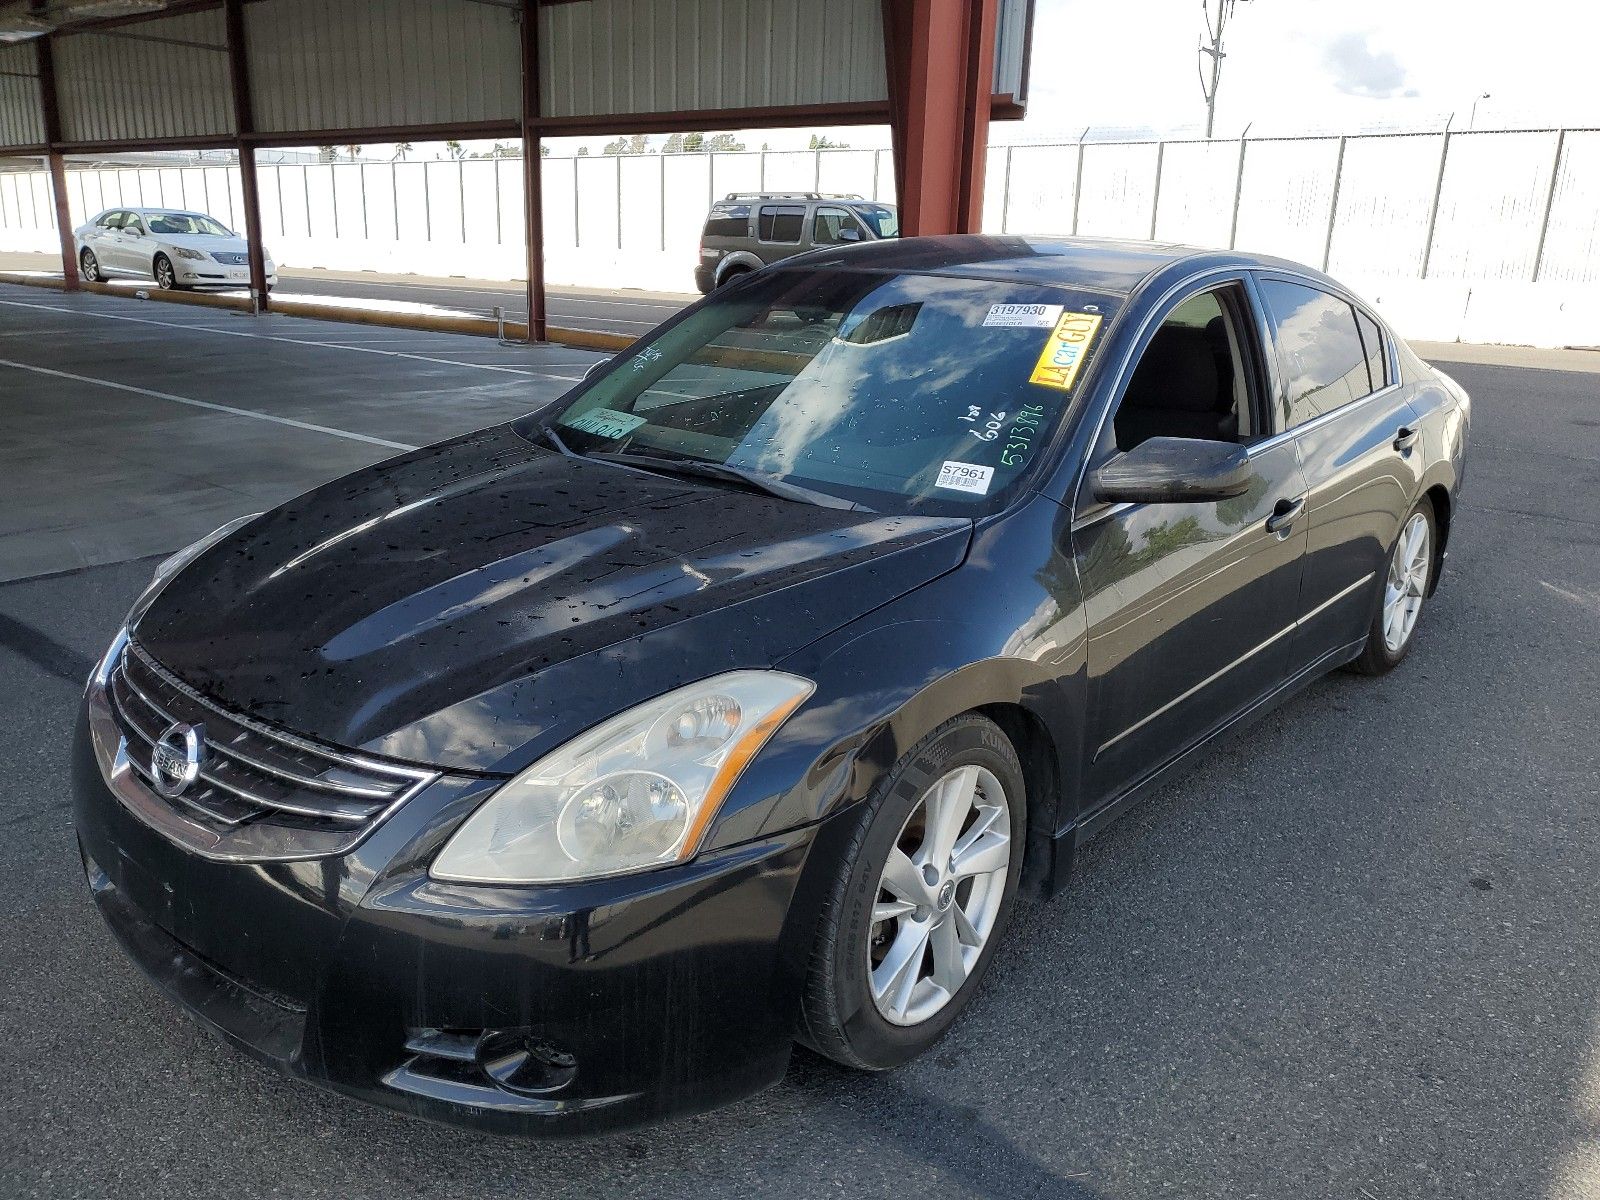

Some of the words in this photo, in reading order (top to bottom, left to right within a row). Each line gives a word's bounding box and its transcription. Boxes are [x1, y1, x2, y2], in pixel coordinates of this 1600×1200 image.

[990, 306, 1046, 316] 3197930
[969, 411, 1006, 442] 606
[1001, 403, 1044, 467] 5313896
[942, 465, 985, 480] S7961
